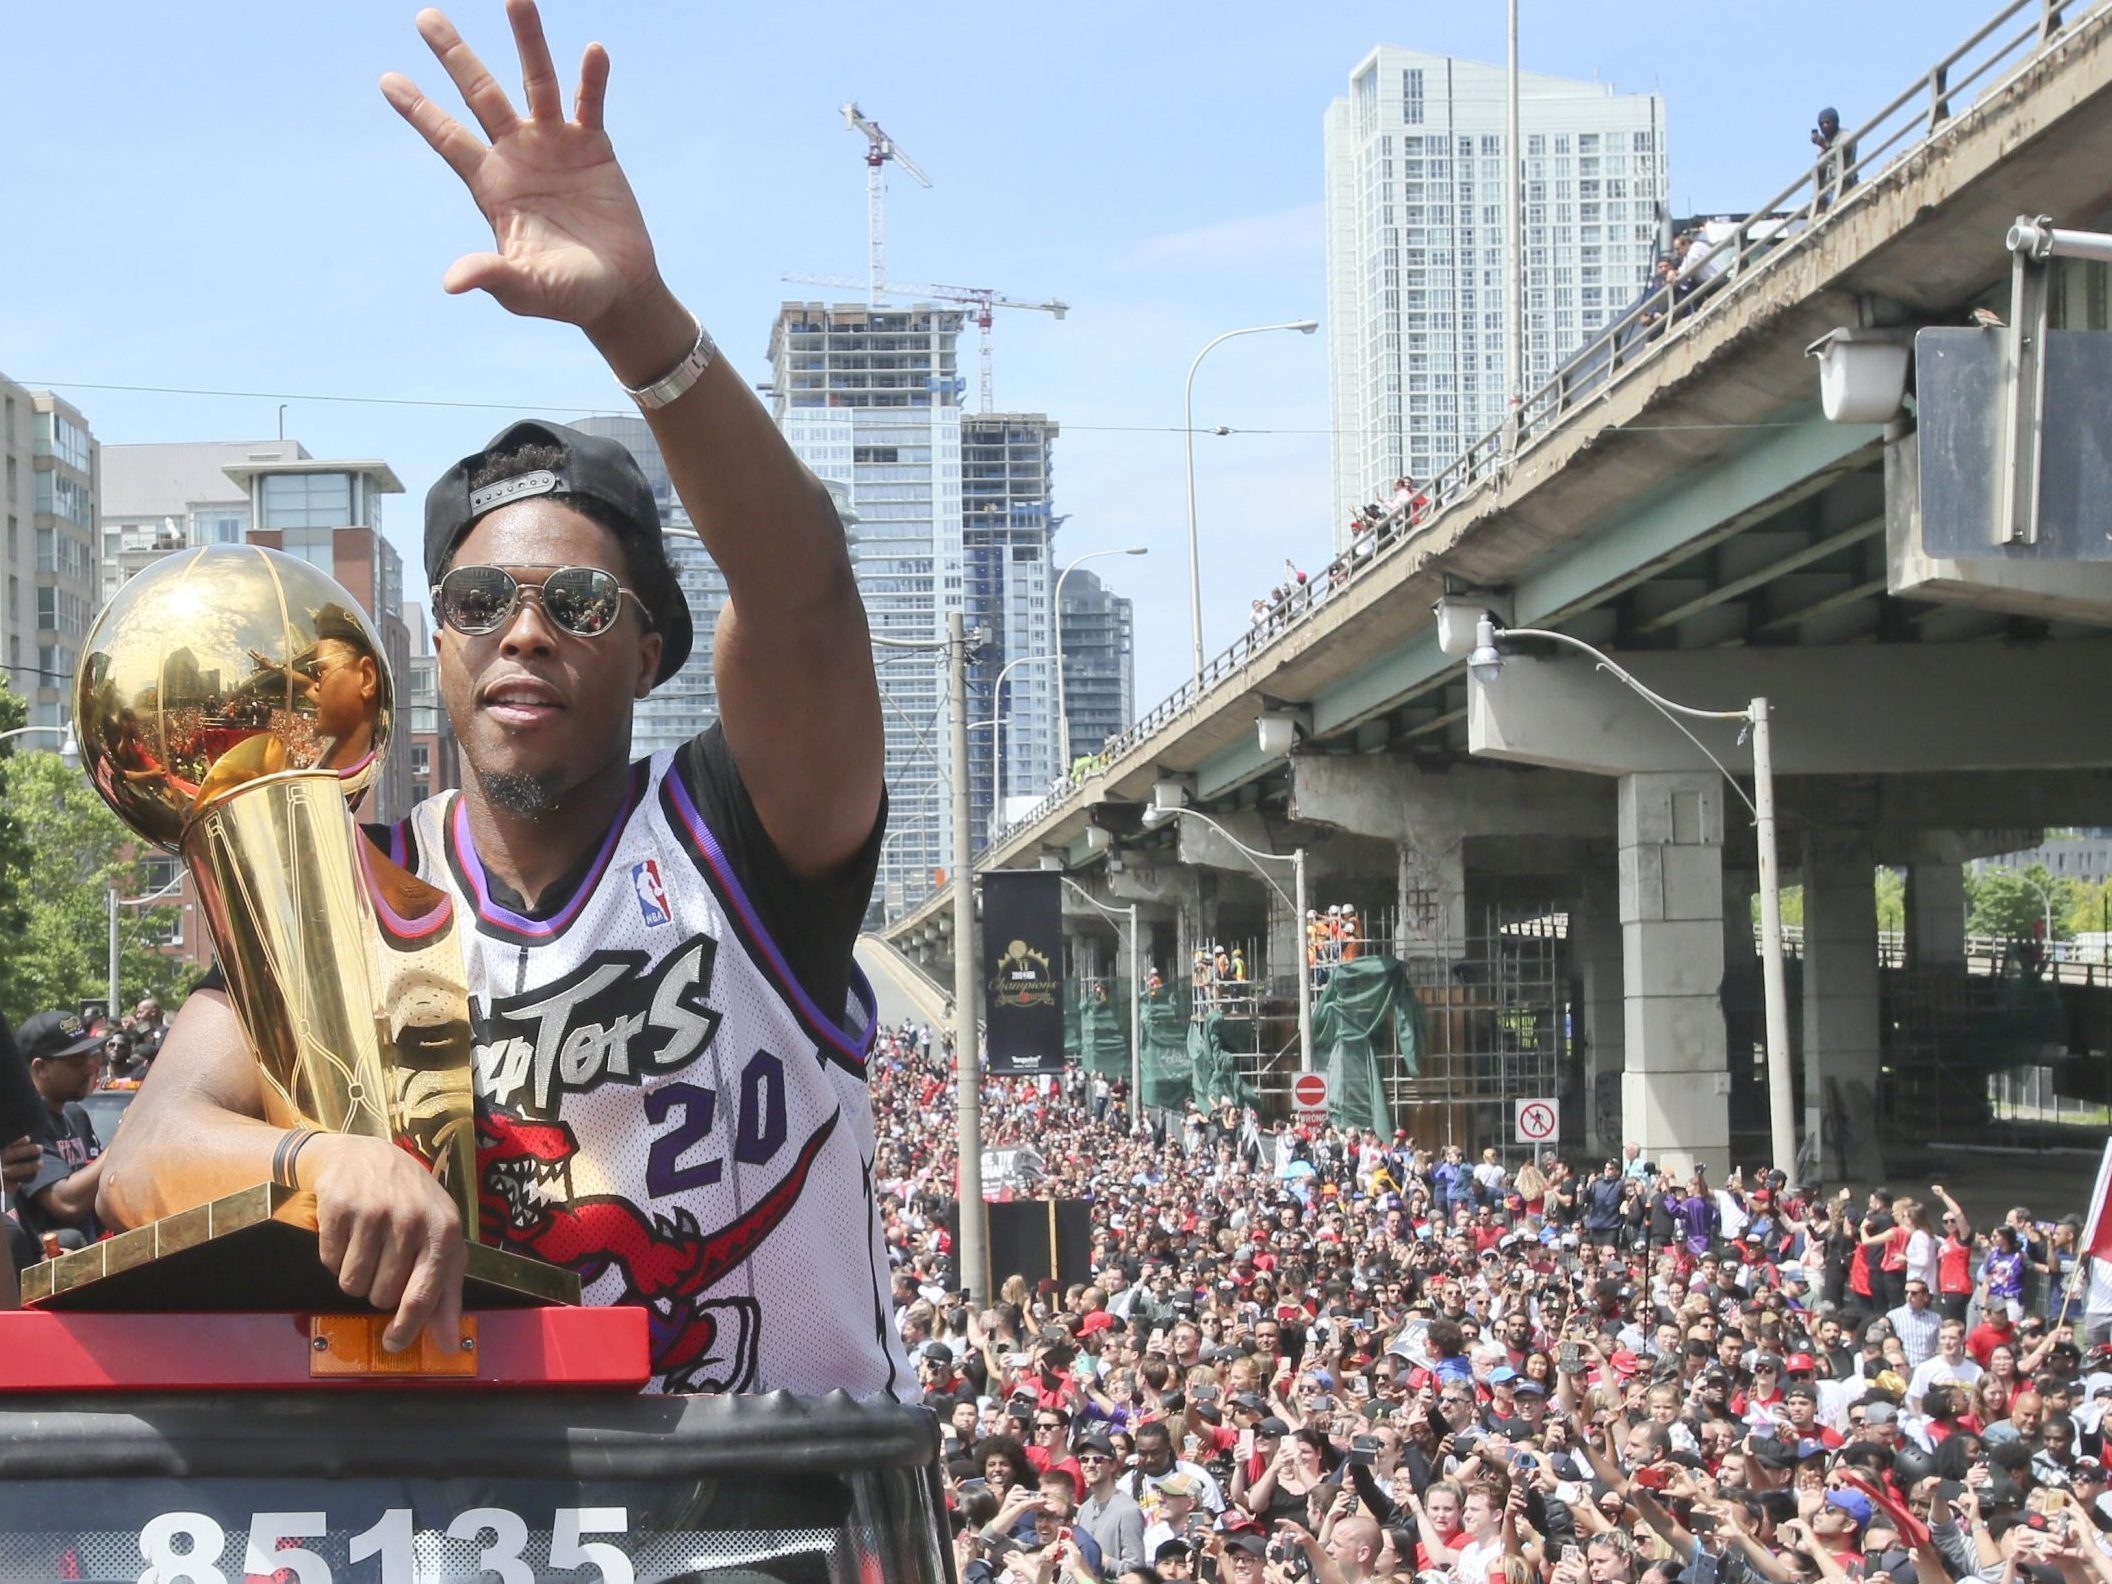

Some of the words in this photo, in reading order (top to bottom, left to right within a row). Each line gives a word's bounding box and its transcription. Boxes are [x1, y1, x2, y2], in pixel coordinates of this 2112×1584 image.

[646, 910, 664, 925] NBA
[643, 1047, 788, 1200] 20
[137, 1507, 634, 1584] 85135
